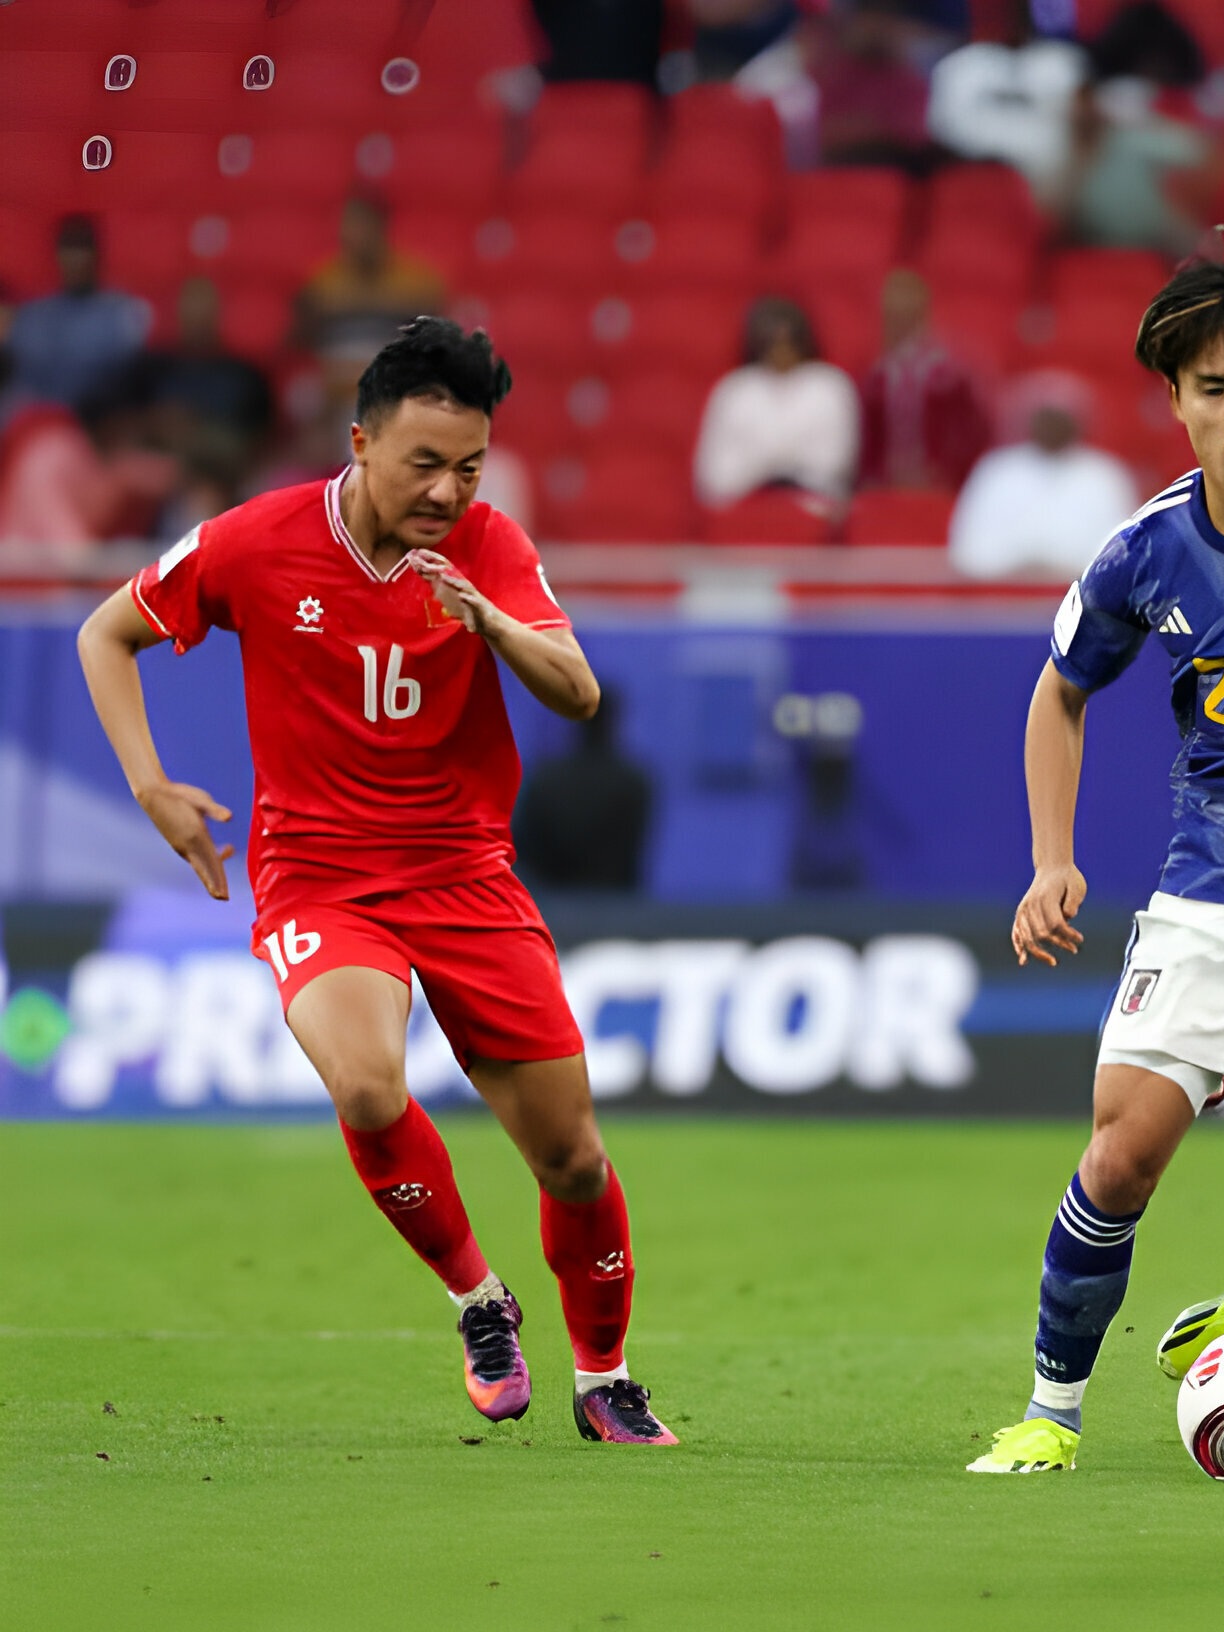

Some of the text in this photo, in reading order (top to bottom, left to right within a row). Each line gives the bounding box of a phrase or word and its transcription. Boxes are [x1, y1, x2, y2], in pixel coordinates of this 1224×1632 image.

[357, 643, 421, 723] 16
[263, 918, 321, 983] 16
[56, 936, 977, 1107] PRCTOR
